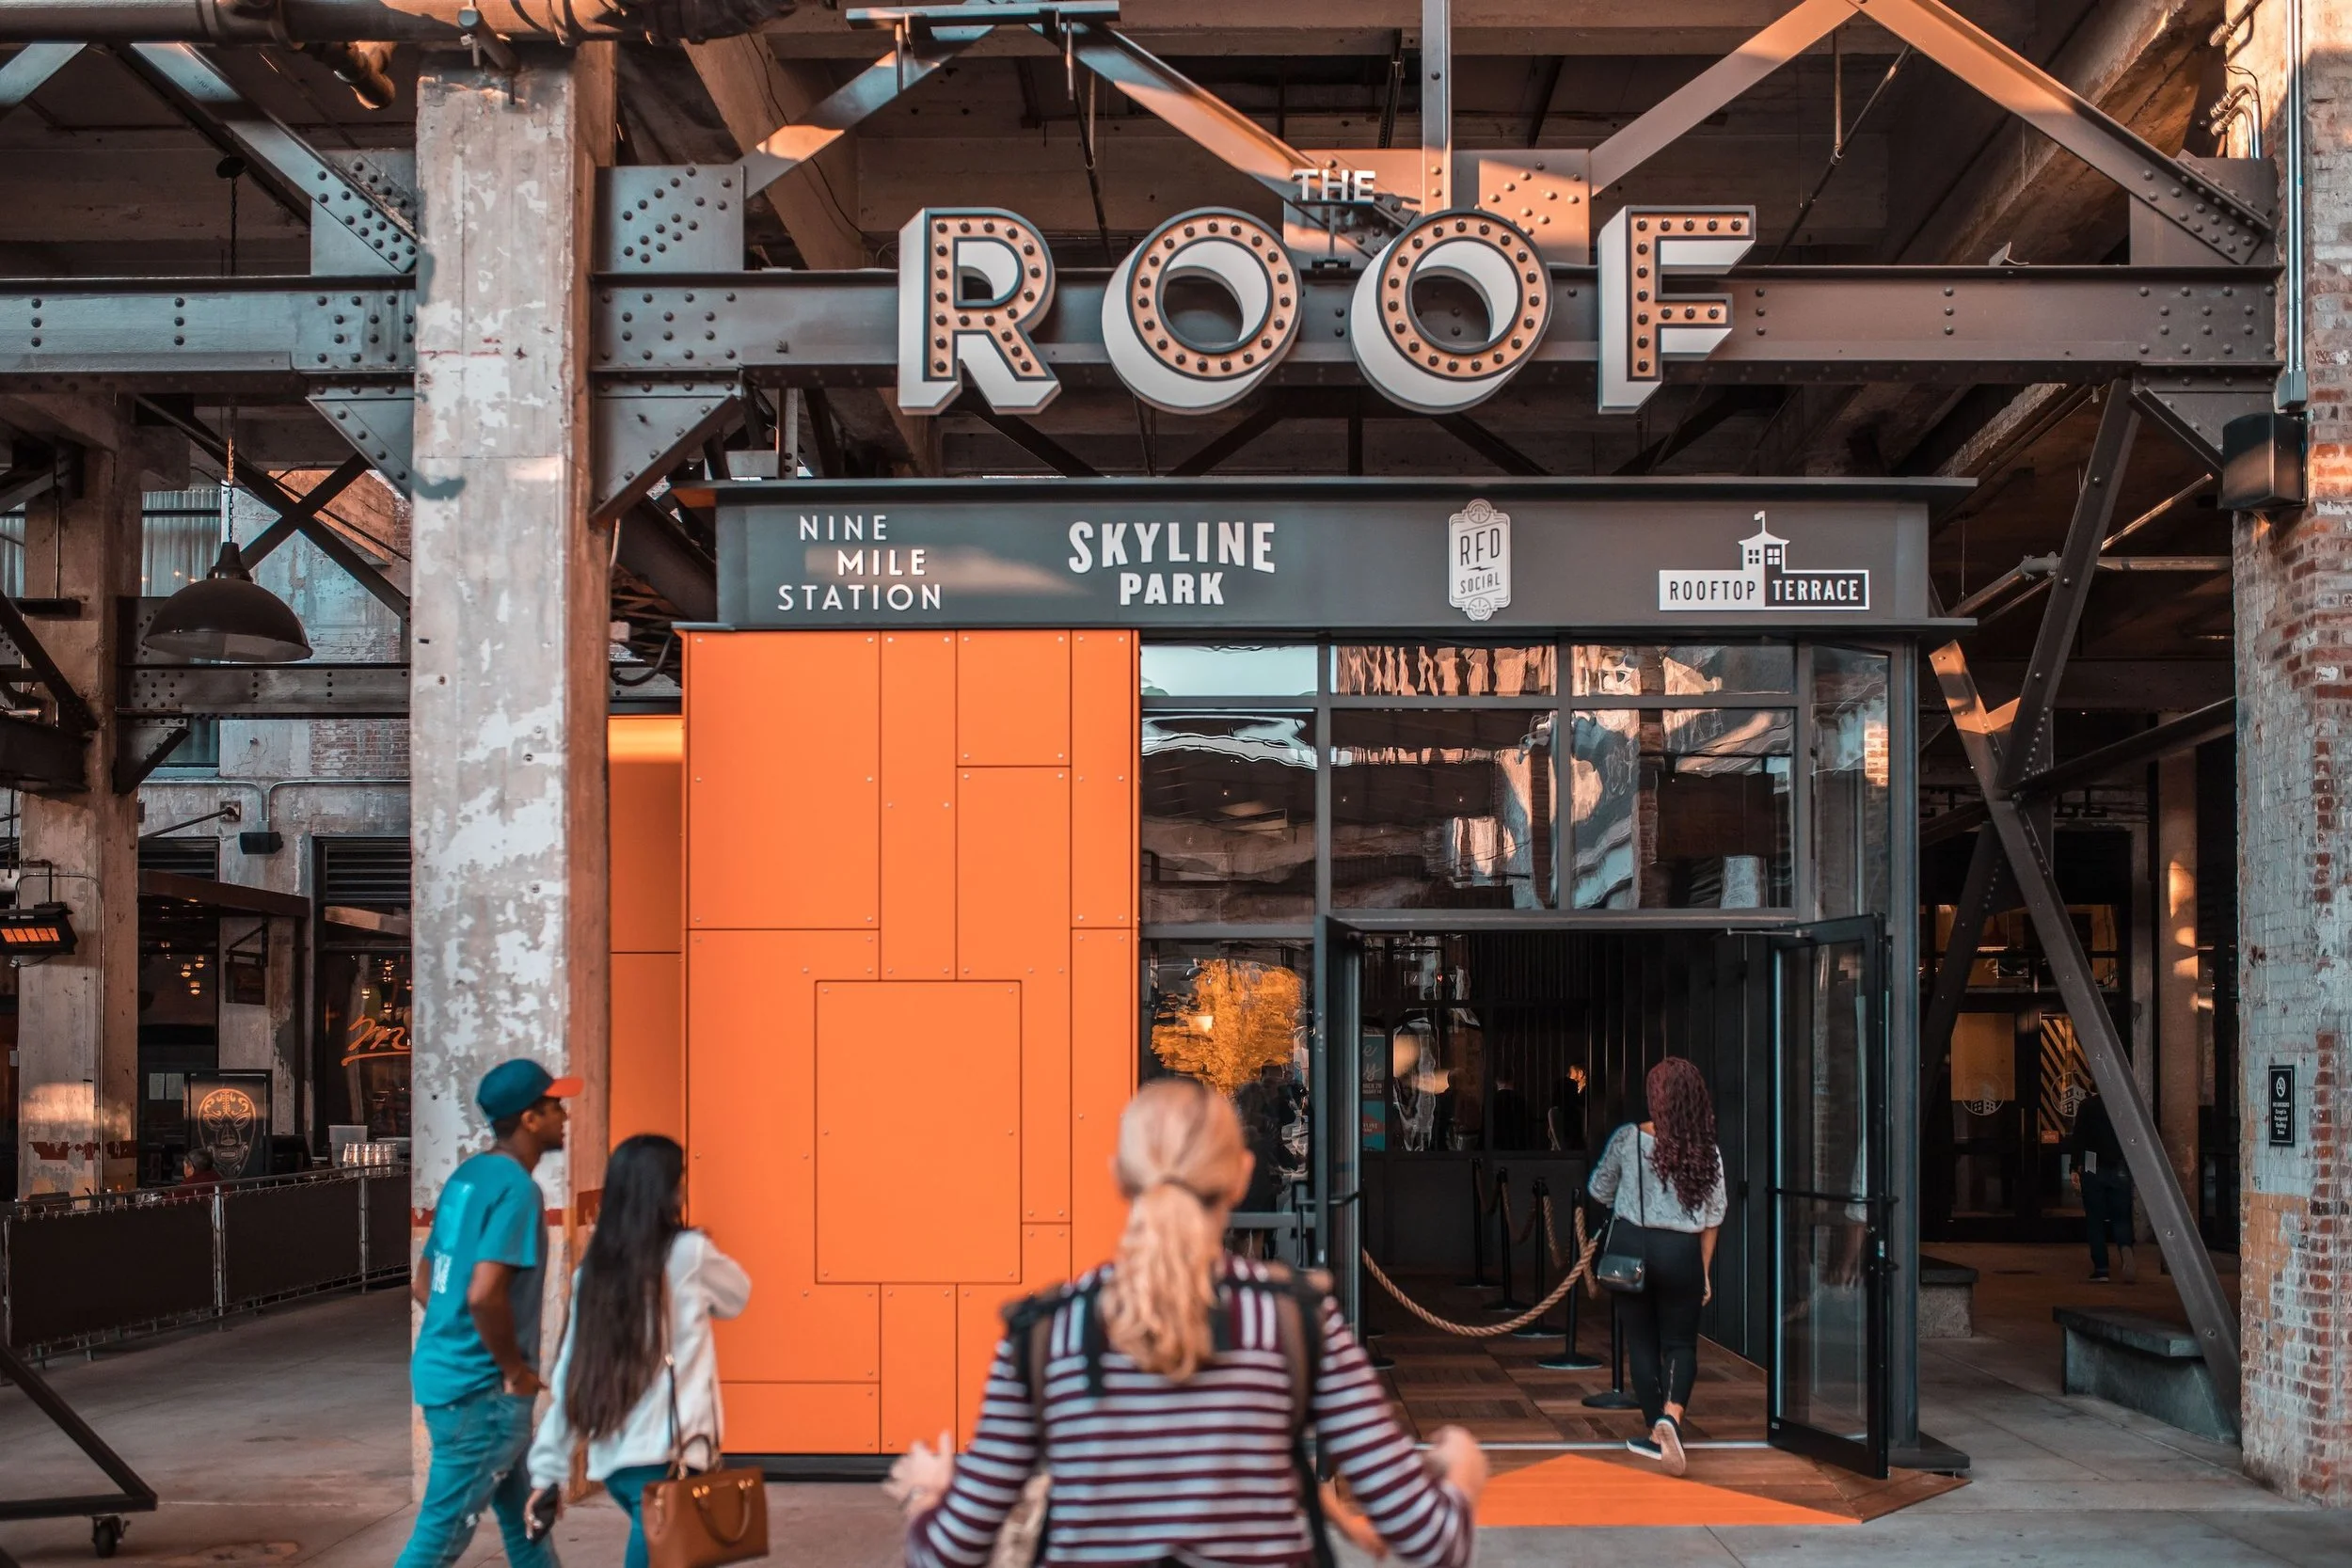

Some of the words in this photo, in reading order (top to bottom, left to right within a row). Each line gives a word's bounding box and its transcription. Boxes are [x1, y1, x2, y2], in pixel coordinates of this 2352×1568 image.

[1293, 168, 1376, 202] THE
[898, 205, 1756, 415] ROOF
[800, 515, 887, 541] NINE
[1069, 521, 1275, 574] SKYLINE
[1460, 528, 1501, 566] RFD
[837, 549, 926, 576] MILE
[777, 583, 941, 611] STATION
[1120, 572, 1224, 605] PARK
[1460, 572, 1501, 594] SOCIAL
[1669, 579, 1756, 601] ROOFTOP
[1772, 579, 1859, 601] TERRACE
